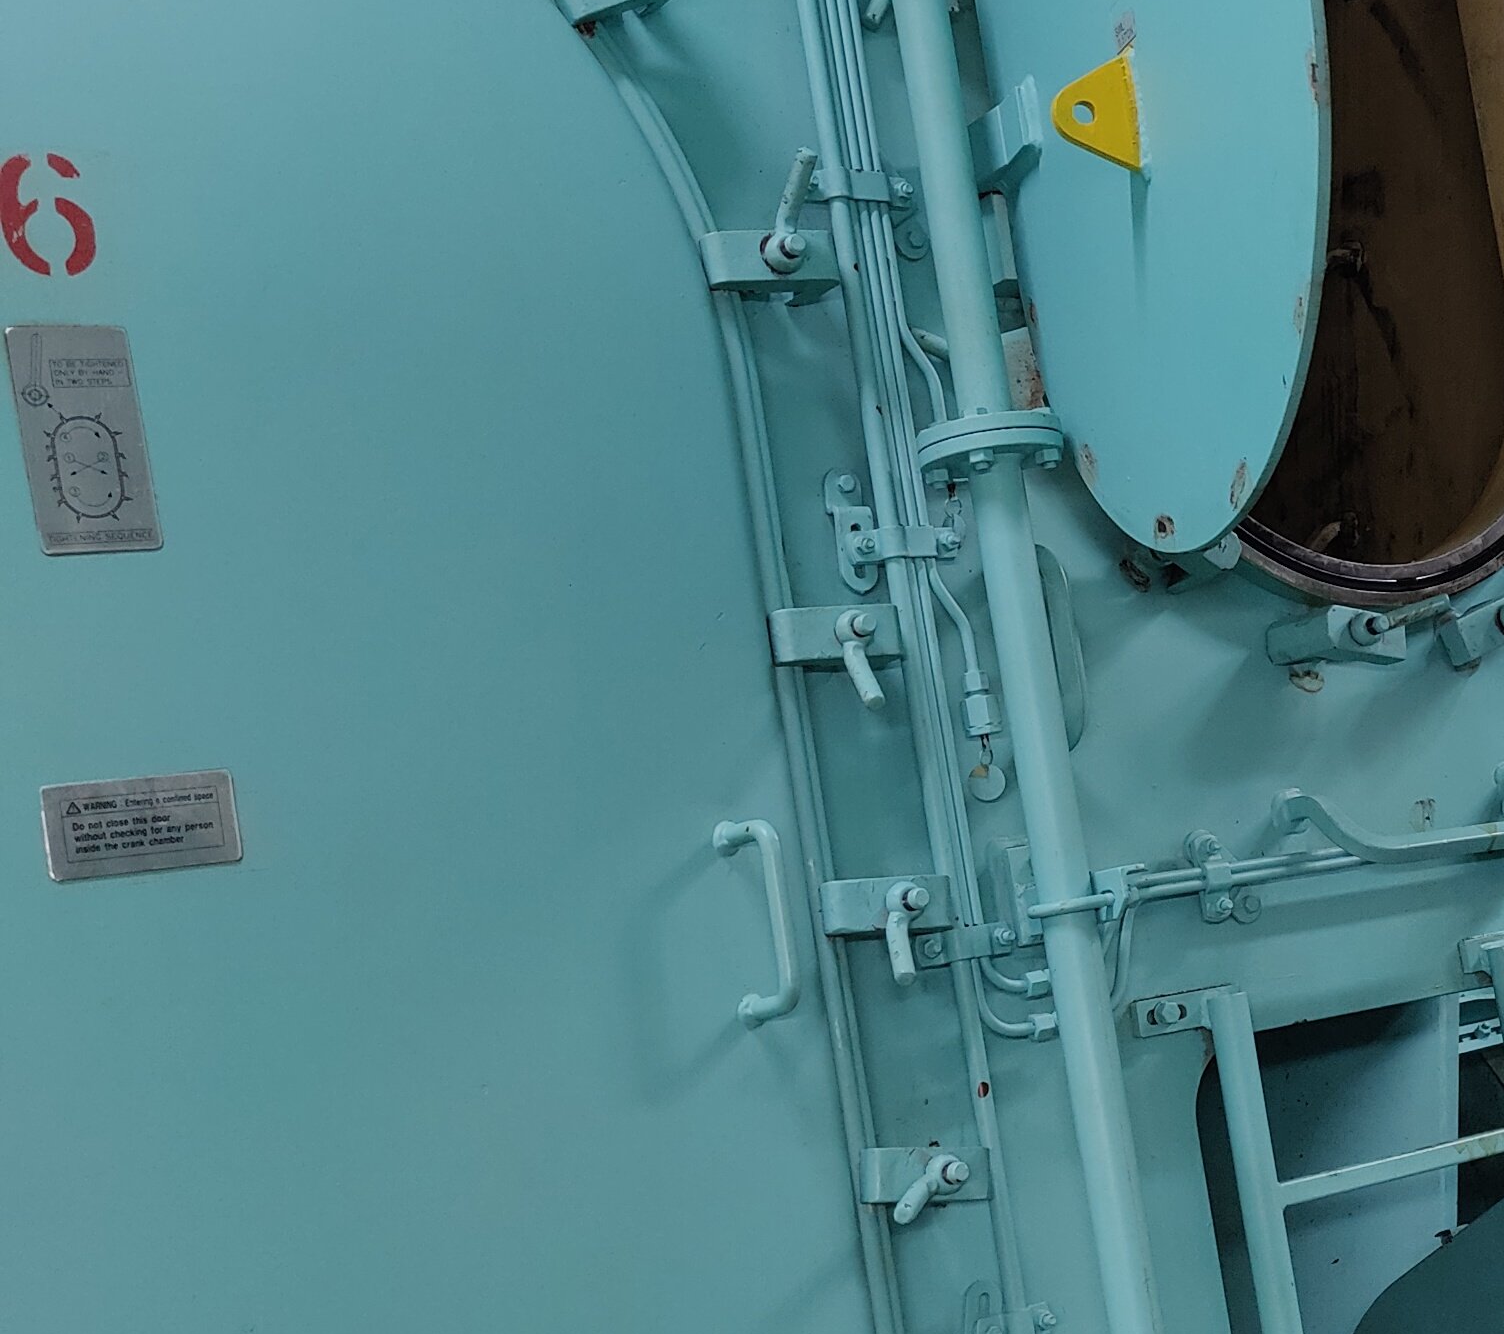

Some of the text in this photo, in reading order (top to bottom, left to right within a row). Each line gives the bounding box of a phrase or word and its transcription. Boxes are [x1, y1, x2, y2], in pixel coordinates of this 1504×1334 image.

[0, 153, 97, 278] 6
[82, 800, 117, 811] WARNING
[125, 797, 154, 807] Entering
[162, 793, 192, 804] confined
[194, 793, 213, 802] space
[72, 814, 171, 832] Do not close this door
[74, 821, 214, 843] without checking for any person
[75, 835, 184, 855] inside the crank chamber
